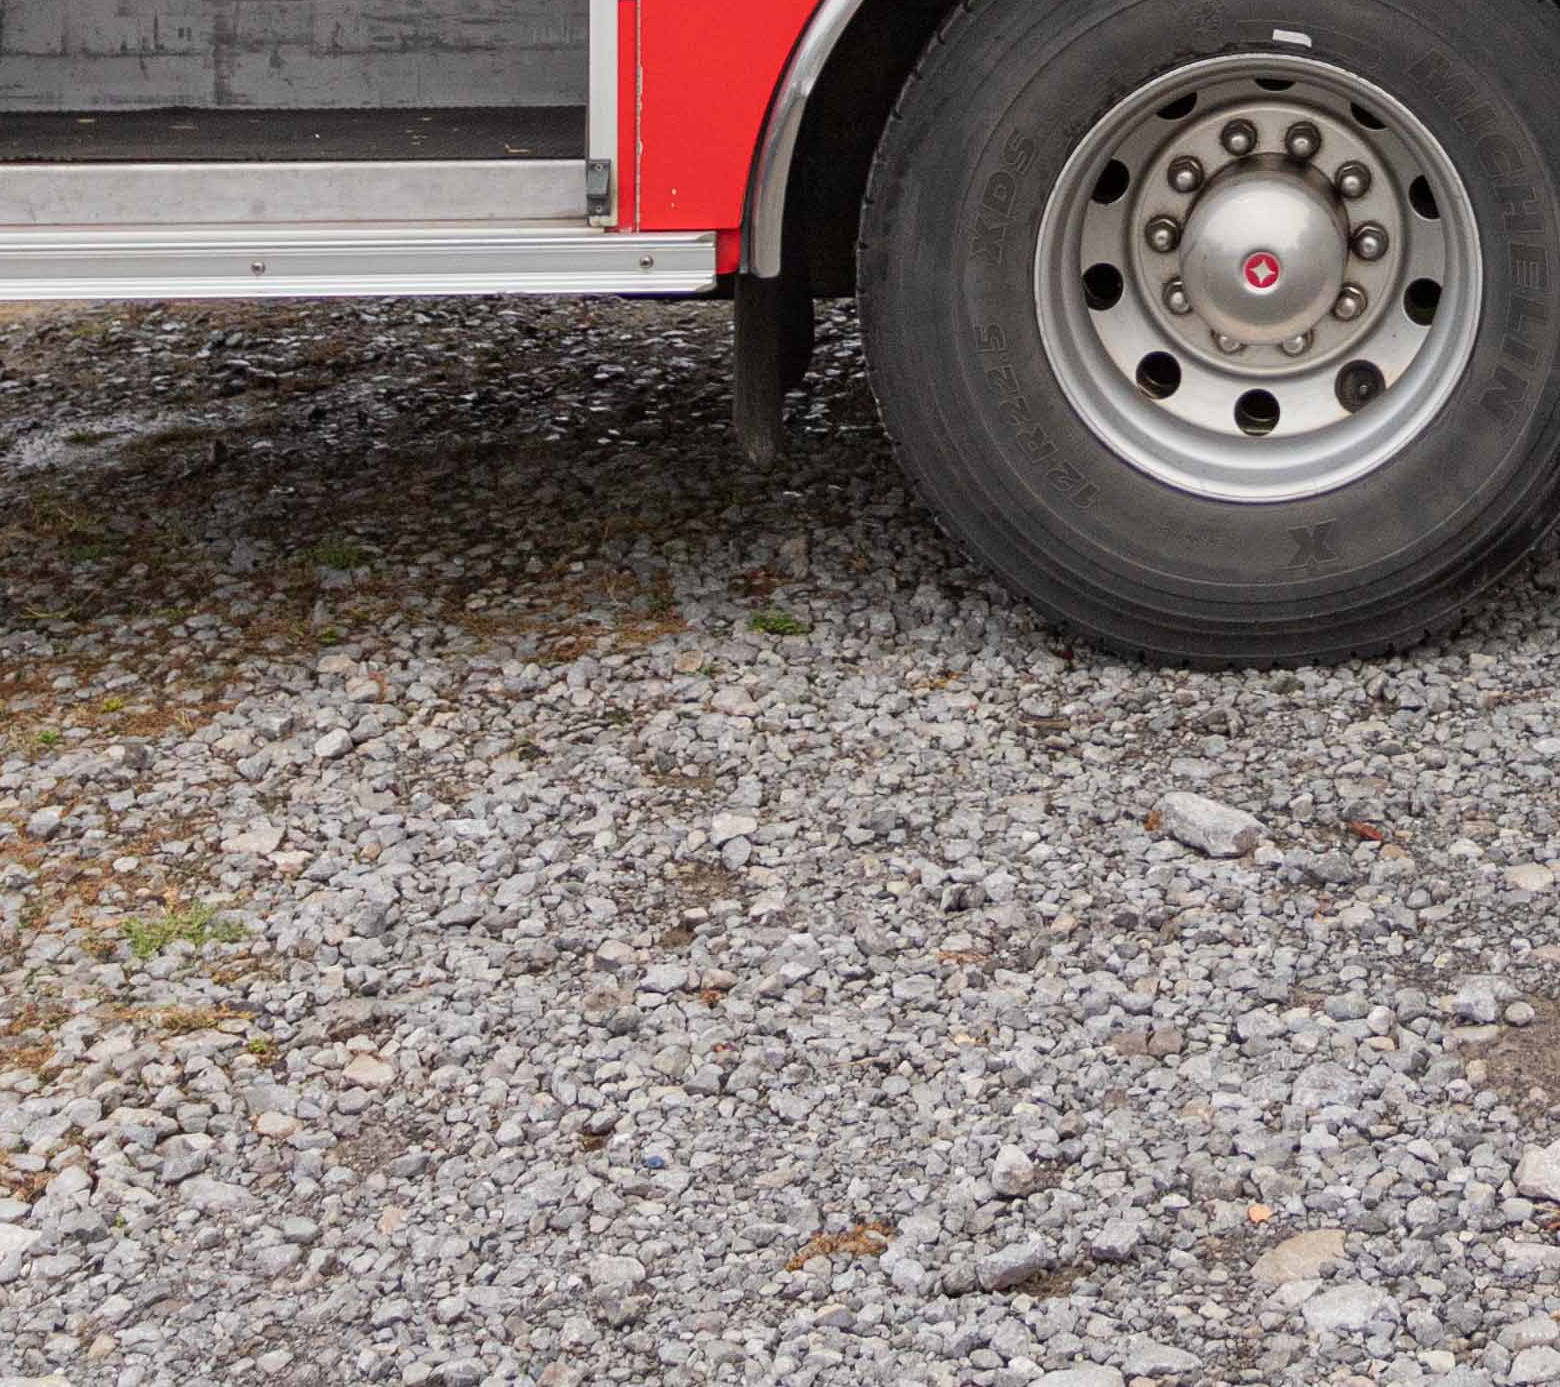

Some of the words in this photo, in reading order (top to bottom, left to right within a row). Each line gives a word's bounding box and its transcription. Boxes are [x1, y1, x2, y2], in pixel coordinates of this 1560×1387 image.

[970, 129, 1039, 265] XDS
[1407, 48, 1551, 429] MICHELIN
[1282, 518, 1340, 570] X
